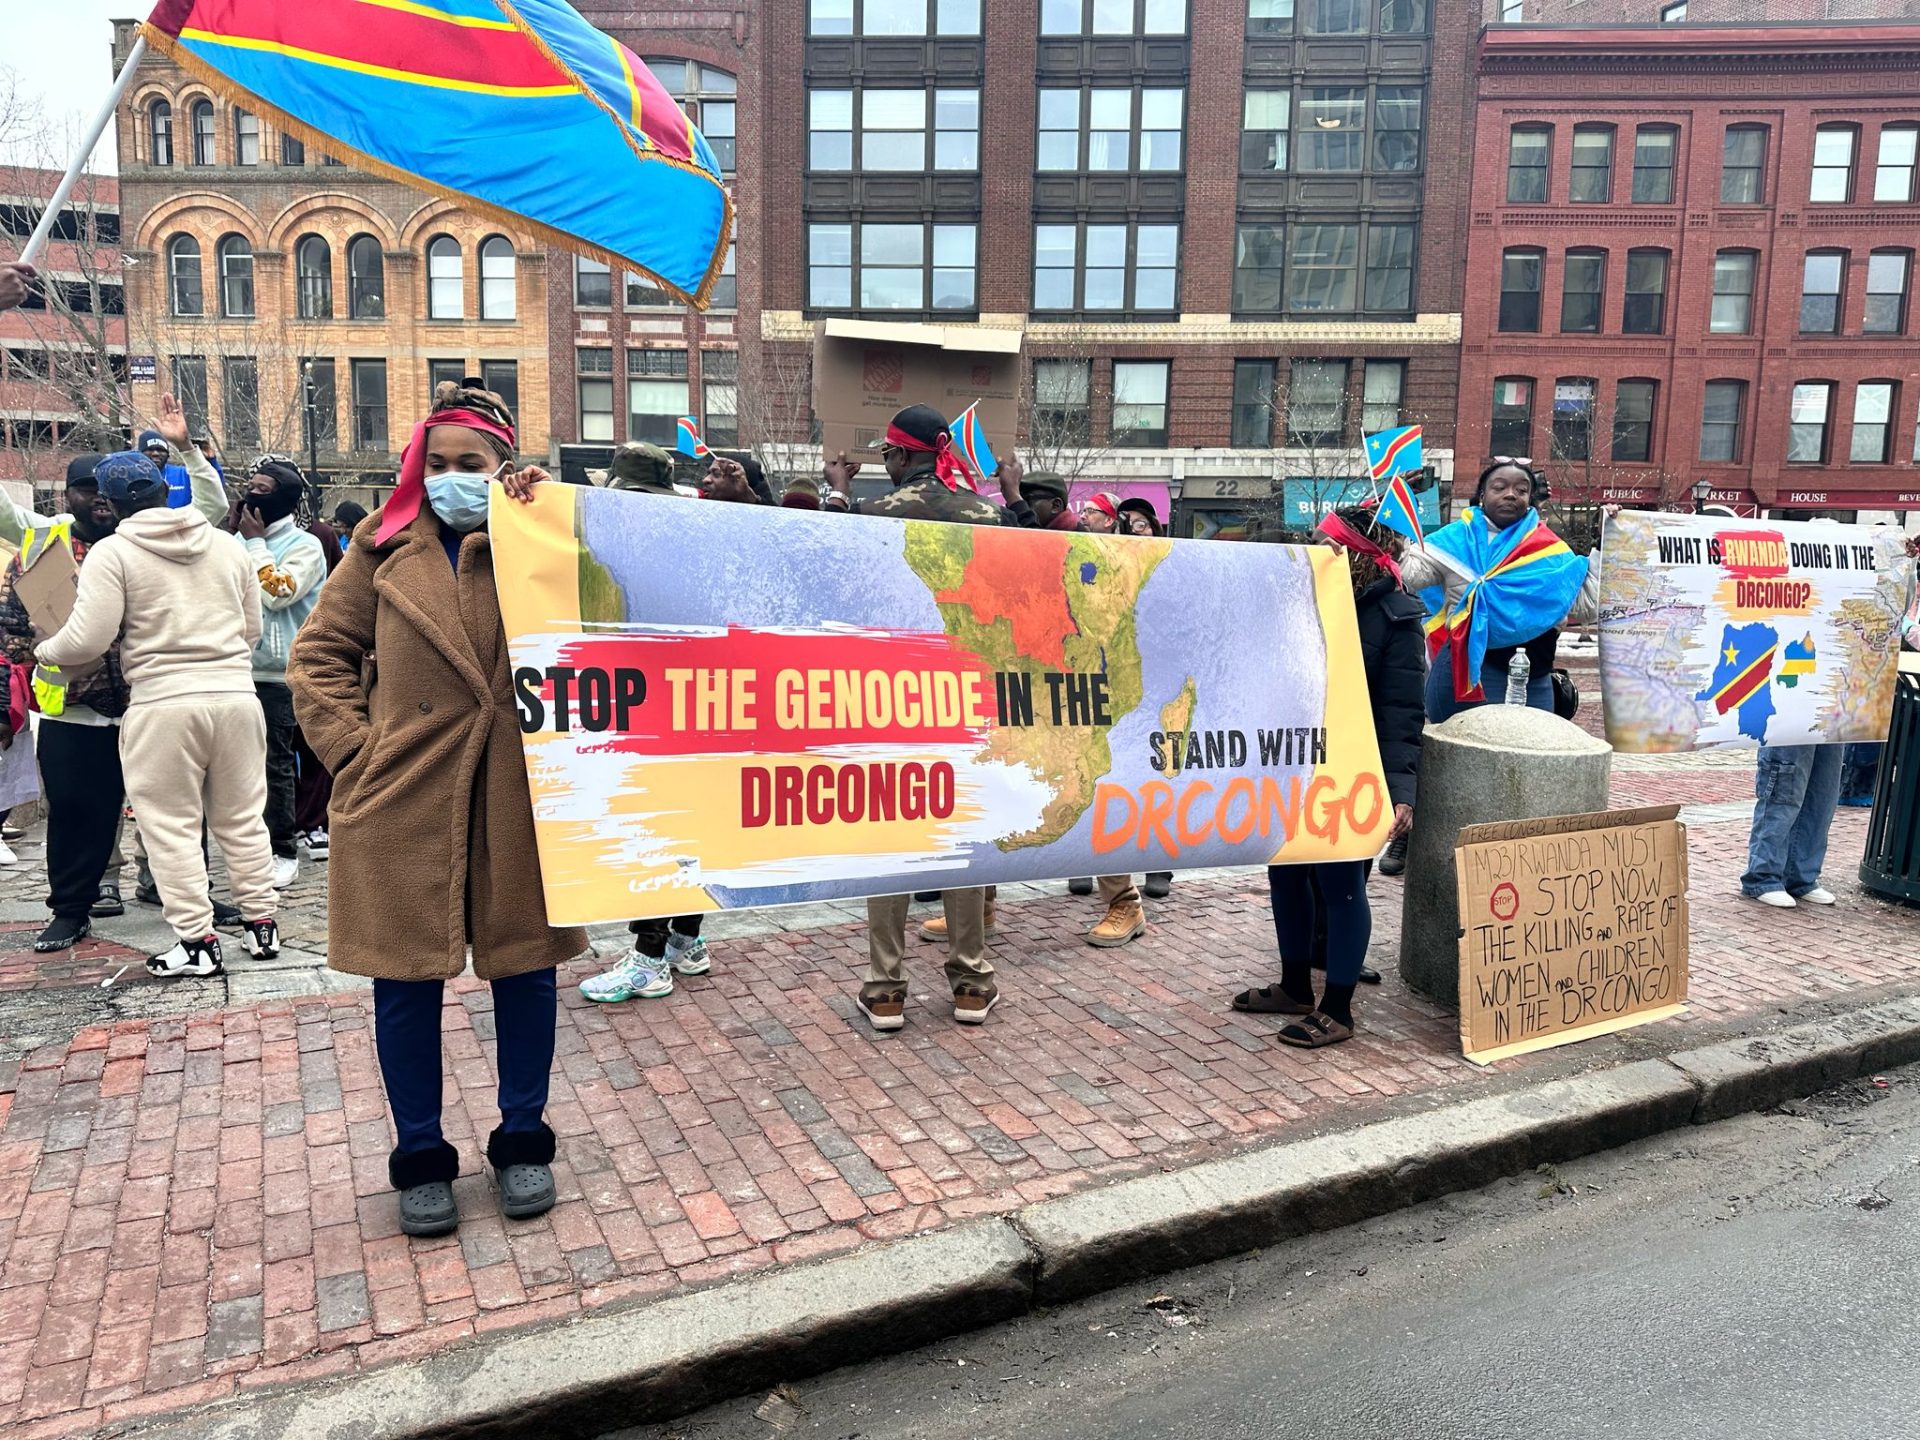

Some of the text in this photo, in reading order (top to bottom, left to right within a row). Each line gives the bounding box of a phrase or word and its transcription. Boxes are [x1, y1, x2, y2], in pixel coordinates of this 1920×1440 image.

[1215, 480, 1239, 496] 22
[1602, 489, 1643, 499] PUBLIC
[1691, 491, 1742, 501] RKET
[1790, 492, 1827, 503] HOUSE
[1657, 536, 1876, 571] WHAT IS RWANDA DOING IN THE
[1736, 581, 1811, 608] DRCONGO?
[514, 666, 1113, 734] STOP THE GENOCIDE IN THE
[1148, 727, 1328, 772] STAND WITH
[740, 761, 955, 829] DRCONGO
[1090, 771, 1384, 859] DRCONGO
[1470, 823, 1498, 842] FREE
[1555, 815, 1585, 833] FREE
[1602, 826, 1661, 868] MUST
[1494, 895, 1513, 906] STOP
[1534, 861, 1663, 916] STOP NOW
[1473, 895, 1678, 966] THE KILLING AND RAPE OF
[1476, 929, 1665, 1008] WOMEN AND CHILDREN
[1494, 1008, 1510, 1043] IN
[1517, 999, 1550, 1036] THE
